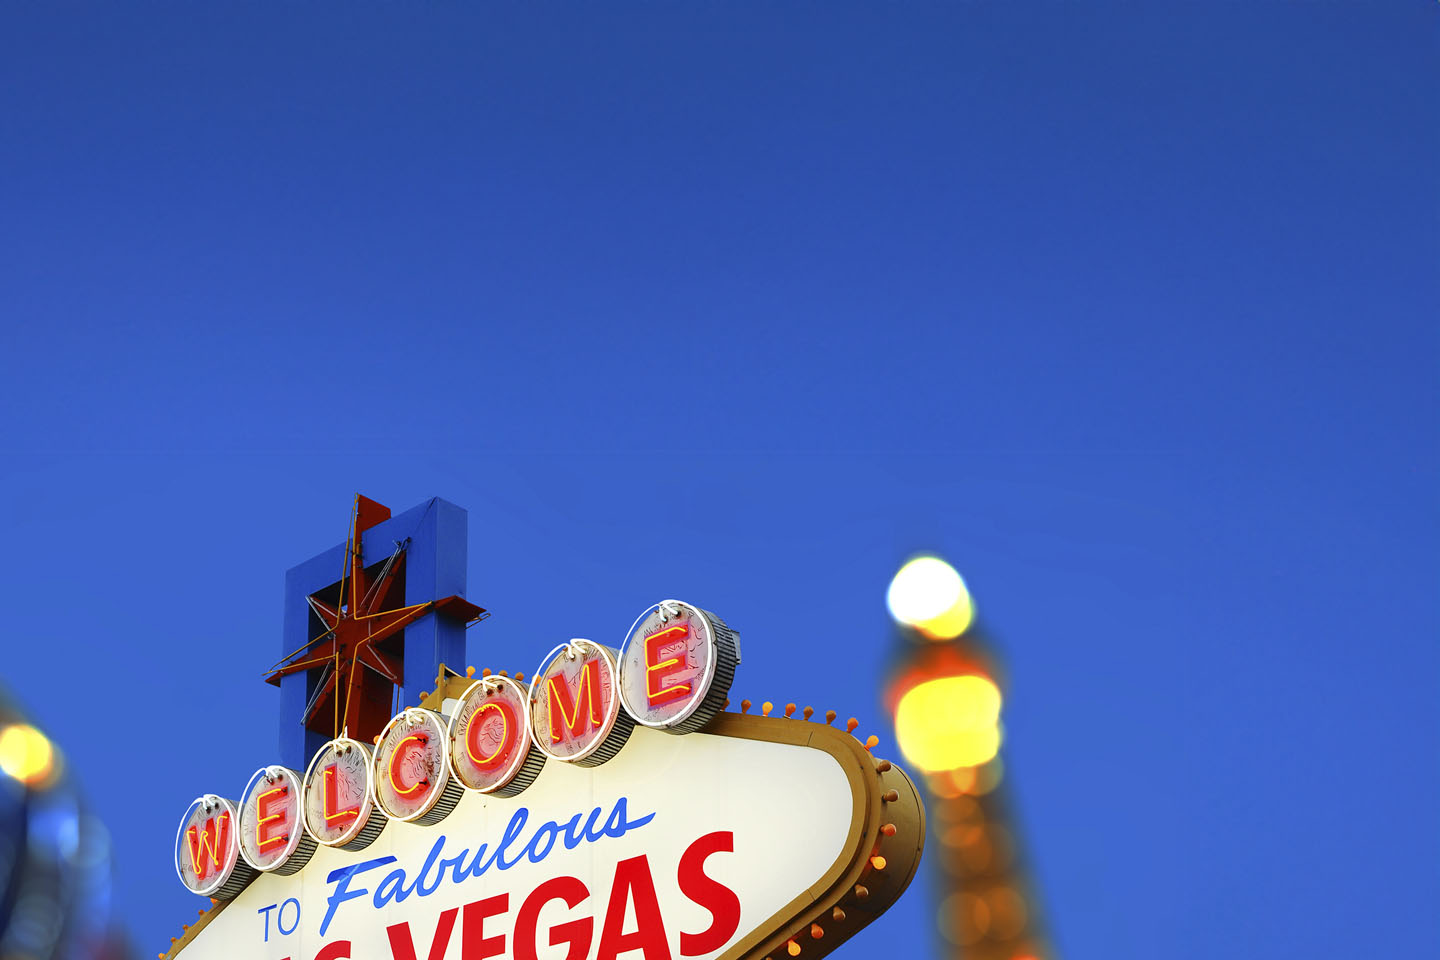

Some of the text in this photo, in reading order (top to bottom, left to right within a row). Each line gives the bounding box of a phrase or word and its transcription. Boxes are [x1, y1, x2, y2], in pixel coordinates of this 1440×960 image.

[186, 624, 690, 881] WELCOME
[258, 796, 657, 942] TO Fabulous
